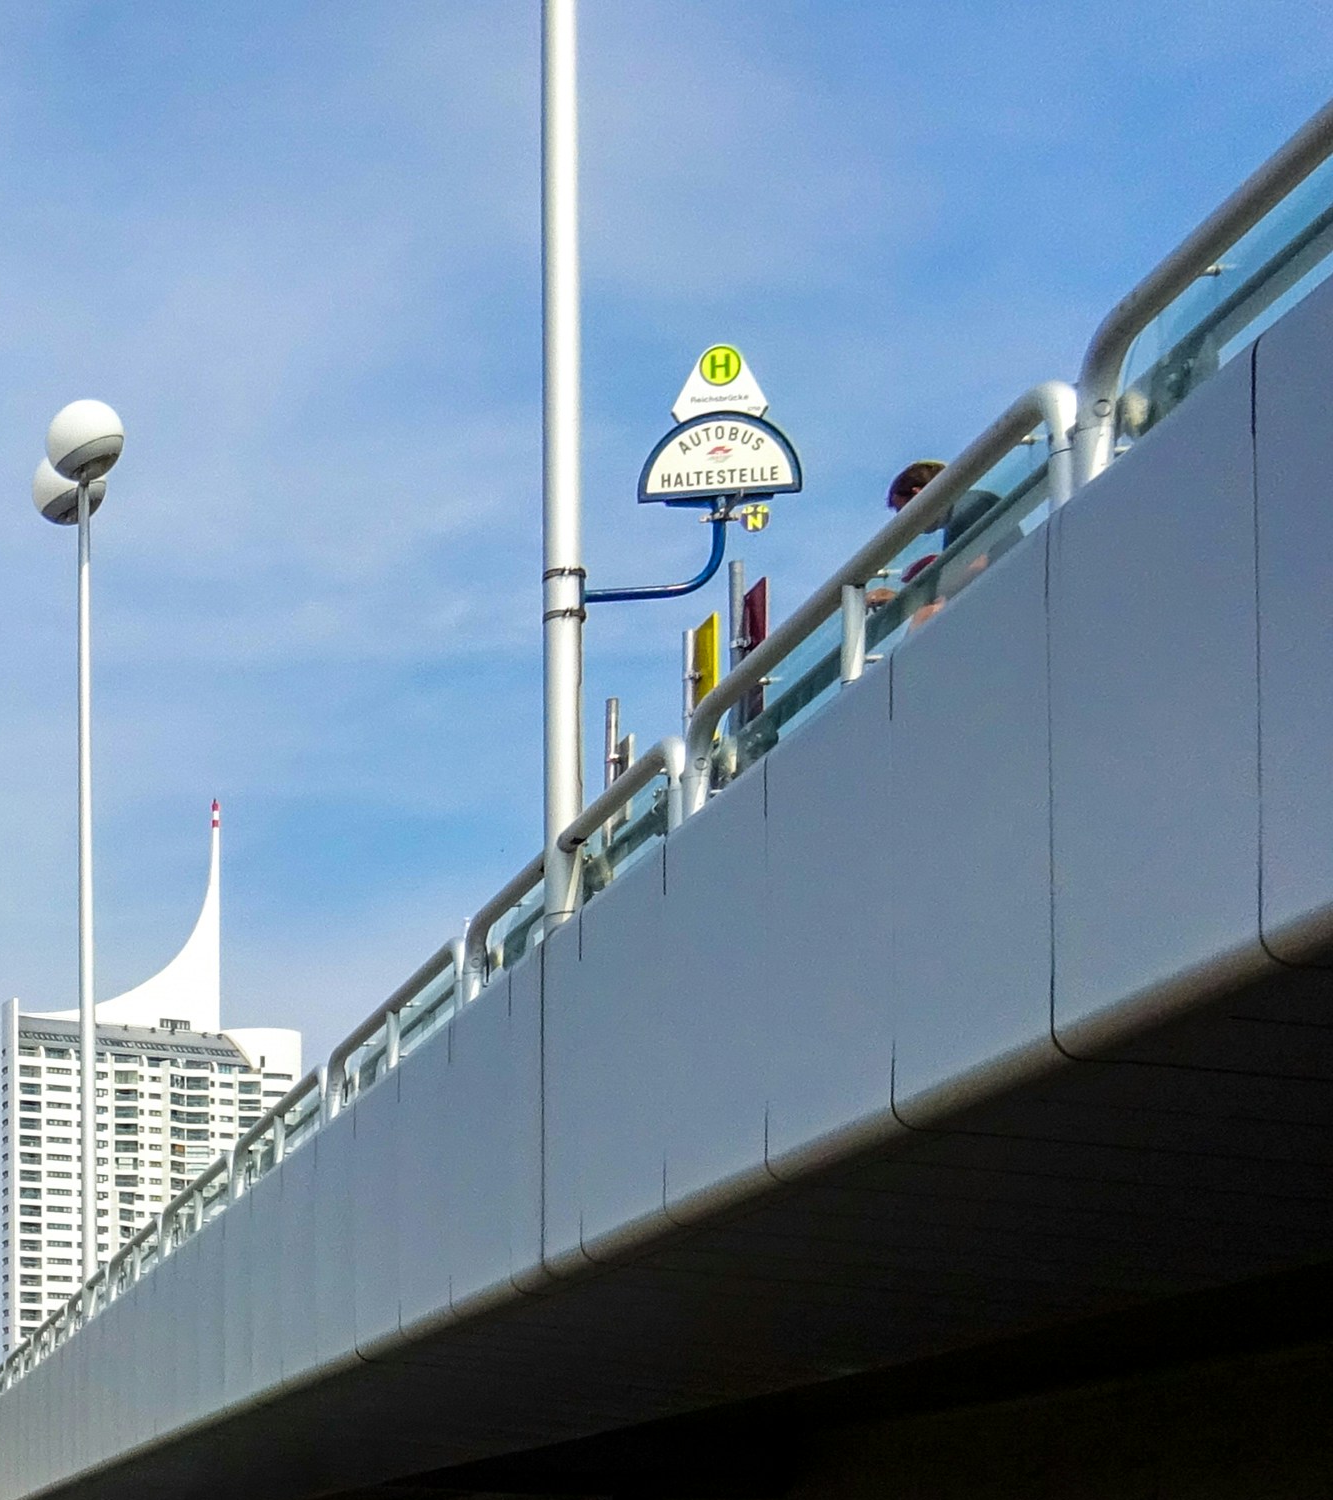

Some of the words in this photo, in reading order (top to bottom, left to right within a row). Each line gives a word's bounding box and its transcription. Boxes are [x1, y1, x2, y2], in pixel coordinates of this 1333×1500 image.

[709, 353, 731, 379] H
[677, 425, 765, 456] AUTOBUS
[660, 465, 780, 489] HALTESTELLE
